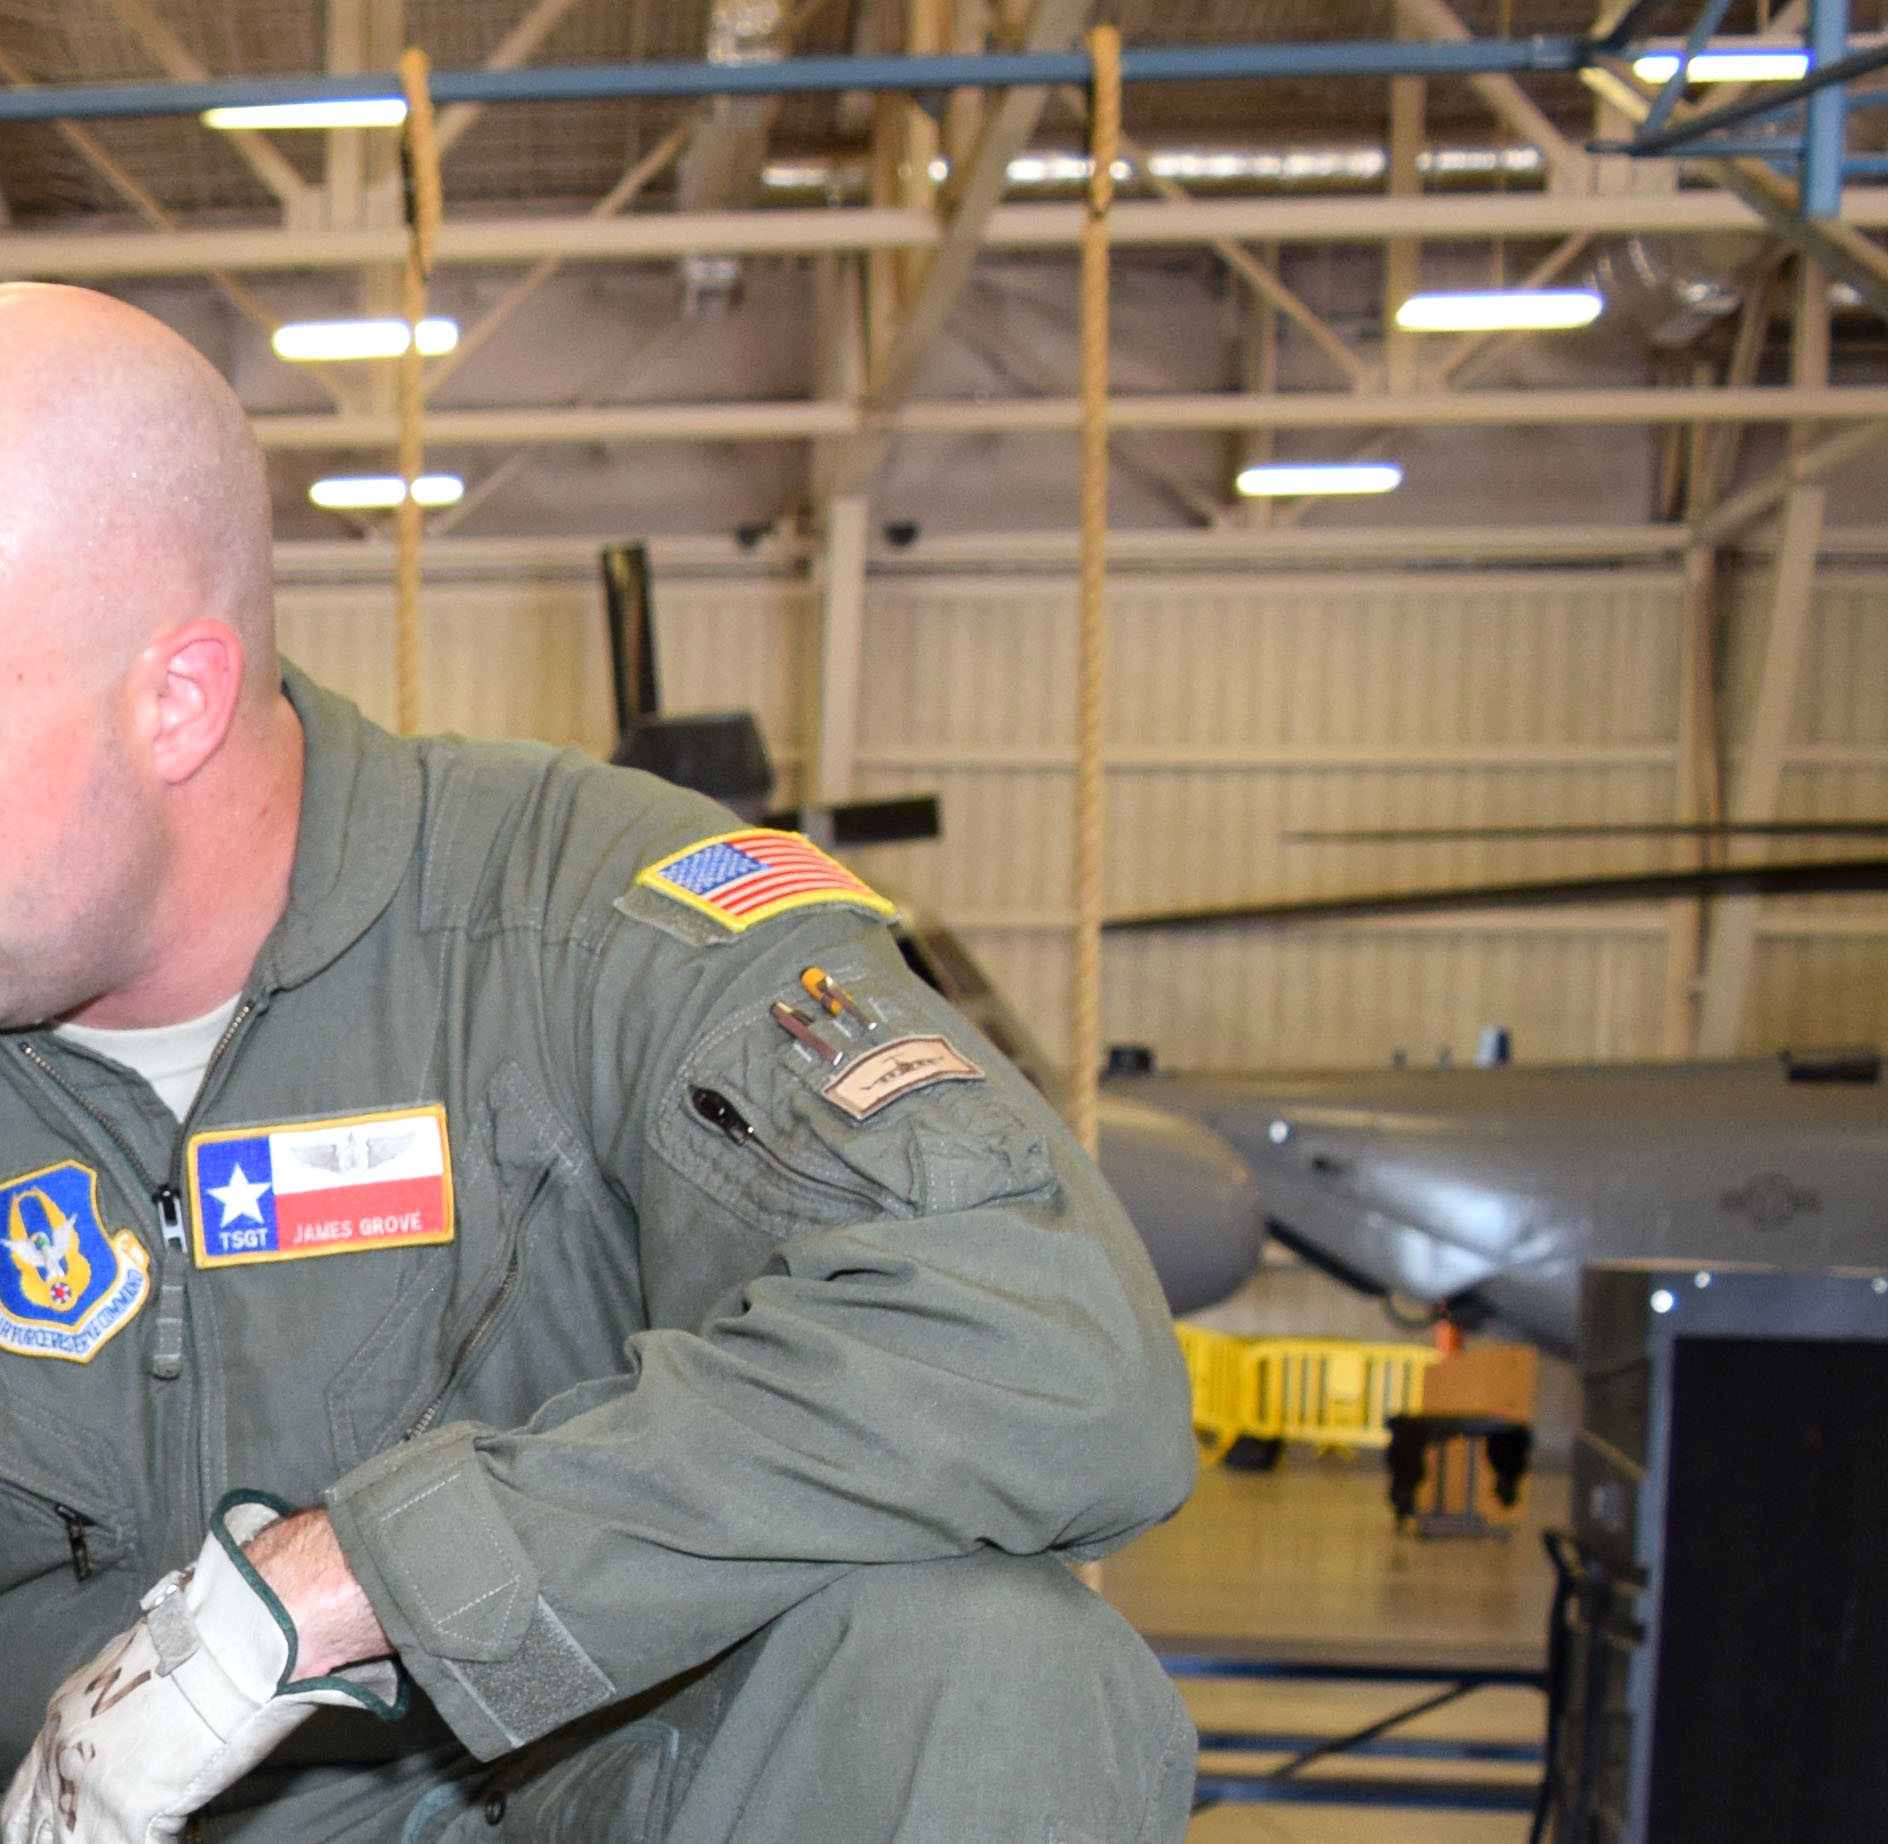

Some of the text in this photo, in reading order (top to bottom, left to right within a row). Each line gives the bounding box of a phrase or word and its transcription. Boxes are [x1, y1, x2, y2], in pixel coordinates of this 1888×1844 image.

[220, 1227, 269, 1251] TSGT
[293, 1212, 423, 1245] JAMES GROVE
